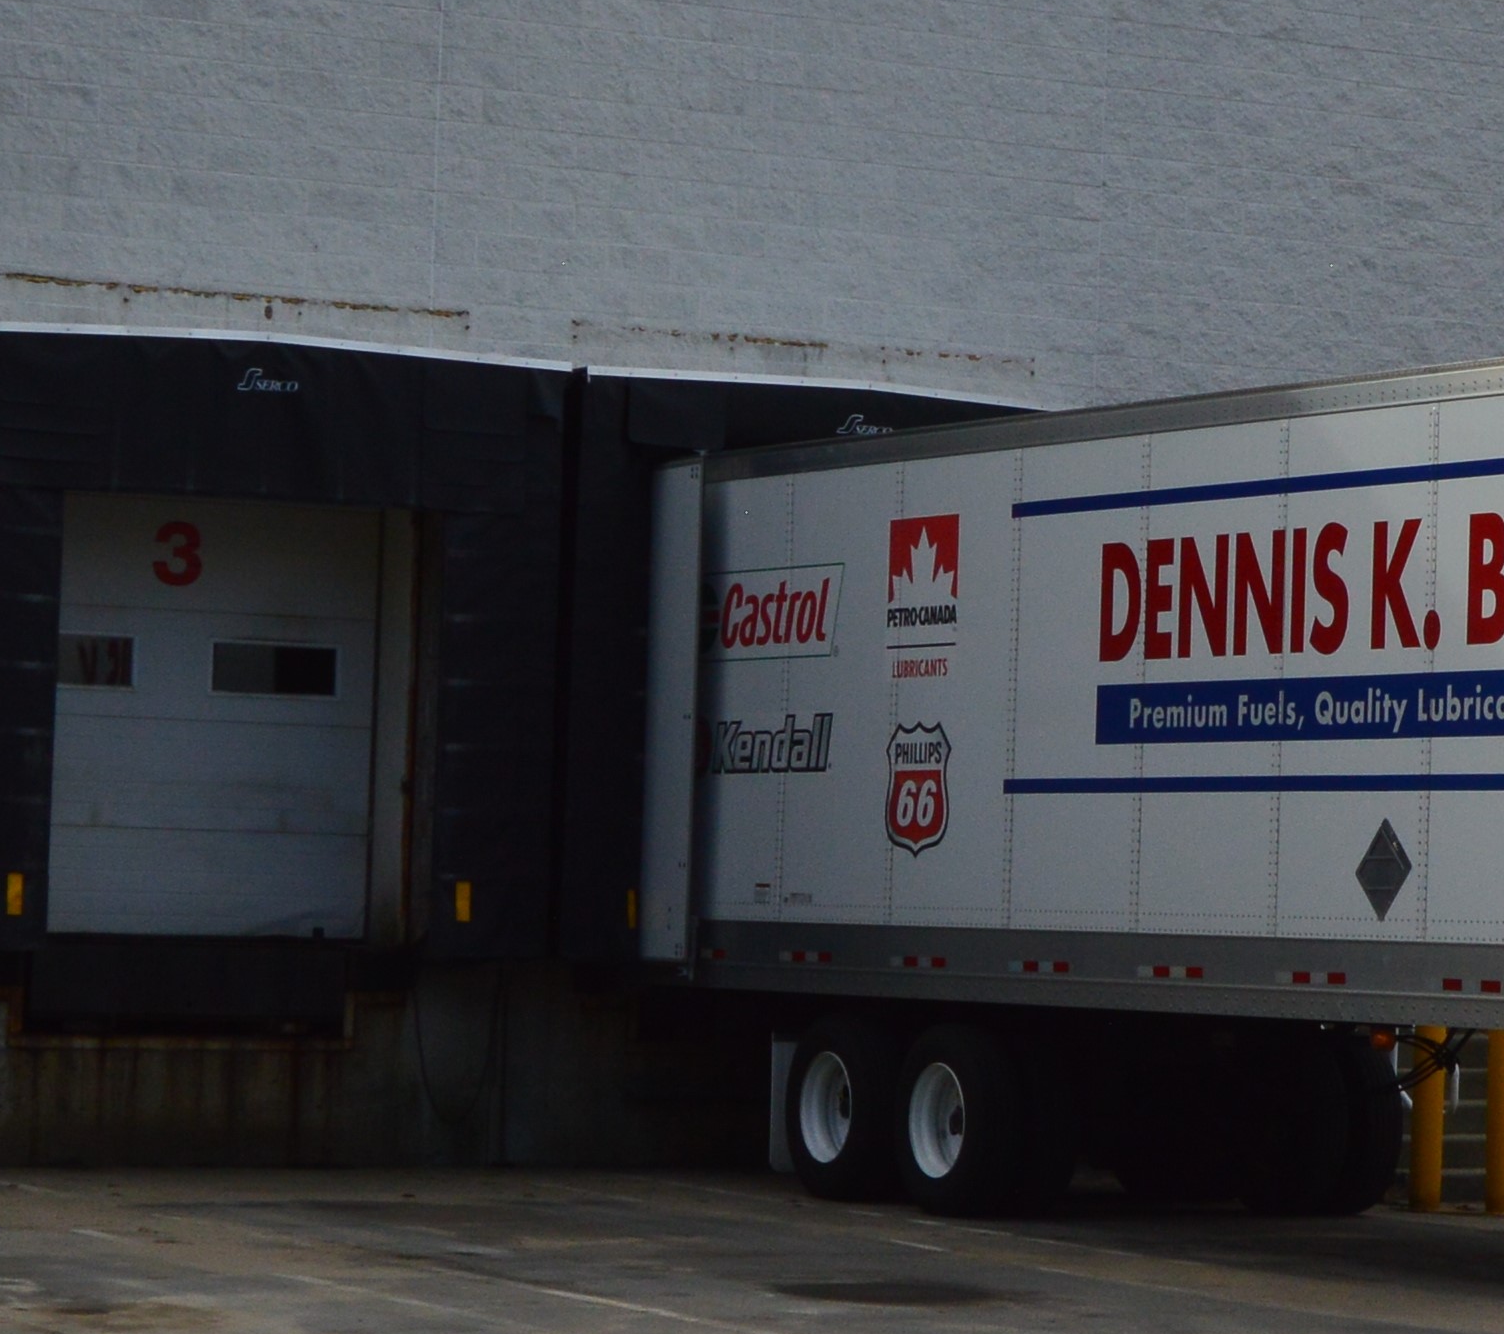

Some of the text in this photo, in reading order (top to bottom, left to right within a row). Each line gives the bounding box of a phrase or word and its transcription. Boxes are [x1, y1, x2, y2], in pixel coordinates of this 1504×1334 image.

[153, 521, 202, 586] 3
[721, 577, 830, 649] Castrol
[1099, 521, 1349, 662] DENNIS
[1370, 518, 1441, 650] K.
[892, 658, 948, 678] LUBRICANTS
[1128, 694, 1228, 729] Premium
[1237, 690, 1305, 730] Fuels,
[1314, 688, 1408, 733] Quality
[712, 712, 833, 774] Kendall
[895, 742, 942, 764] PHILLIPS
[896, 779, 937, 828] 66
